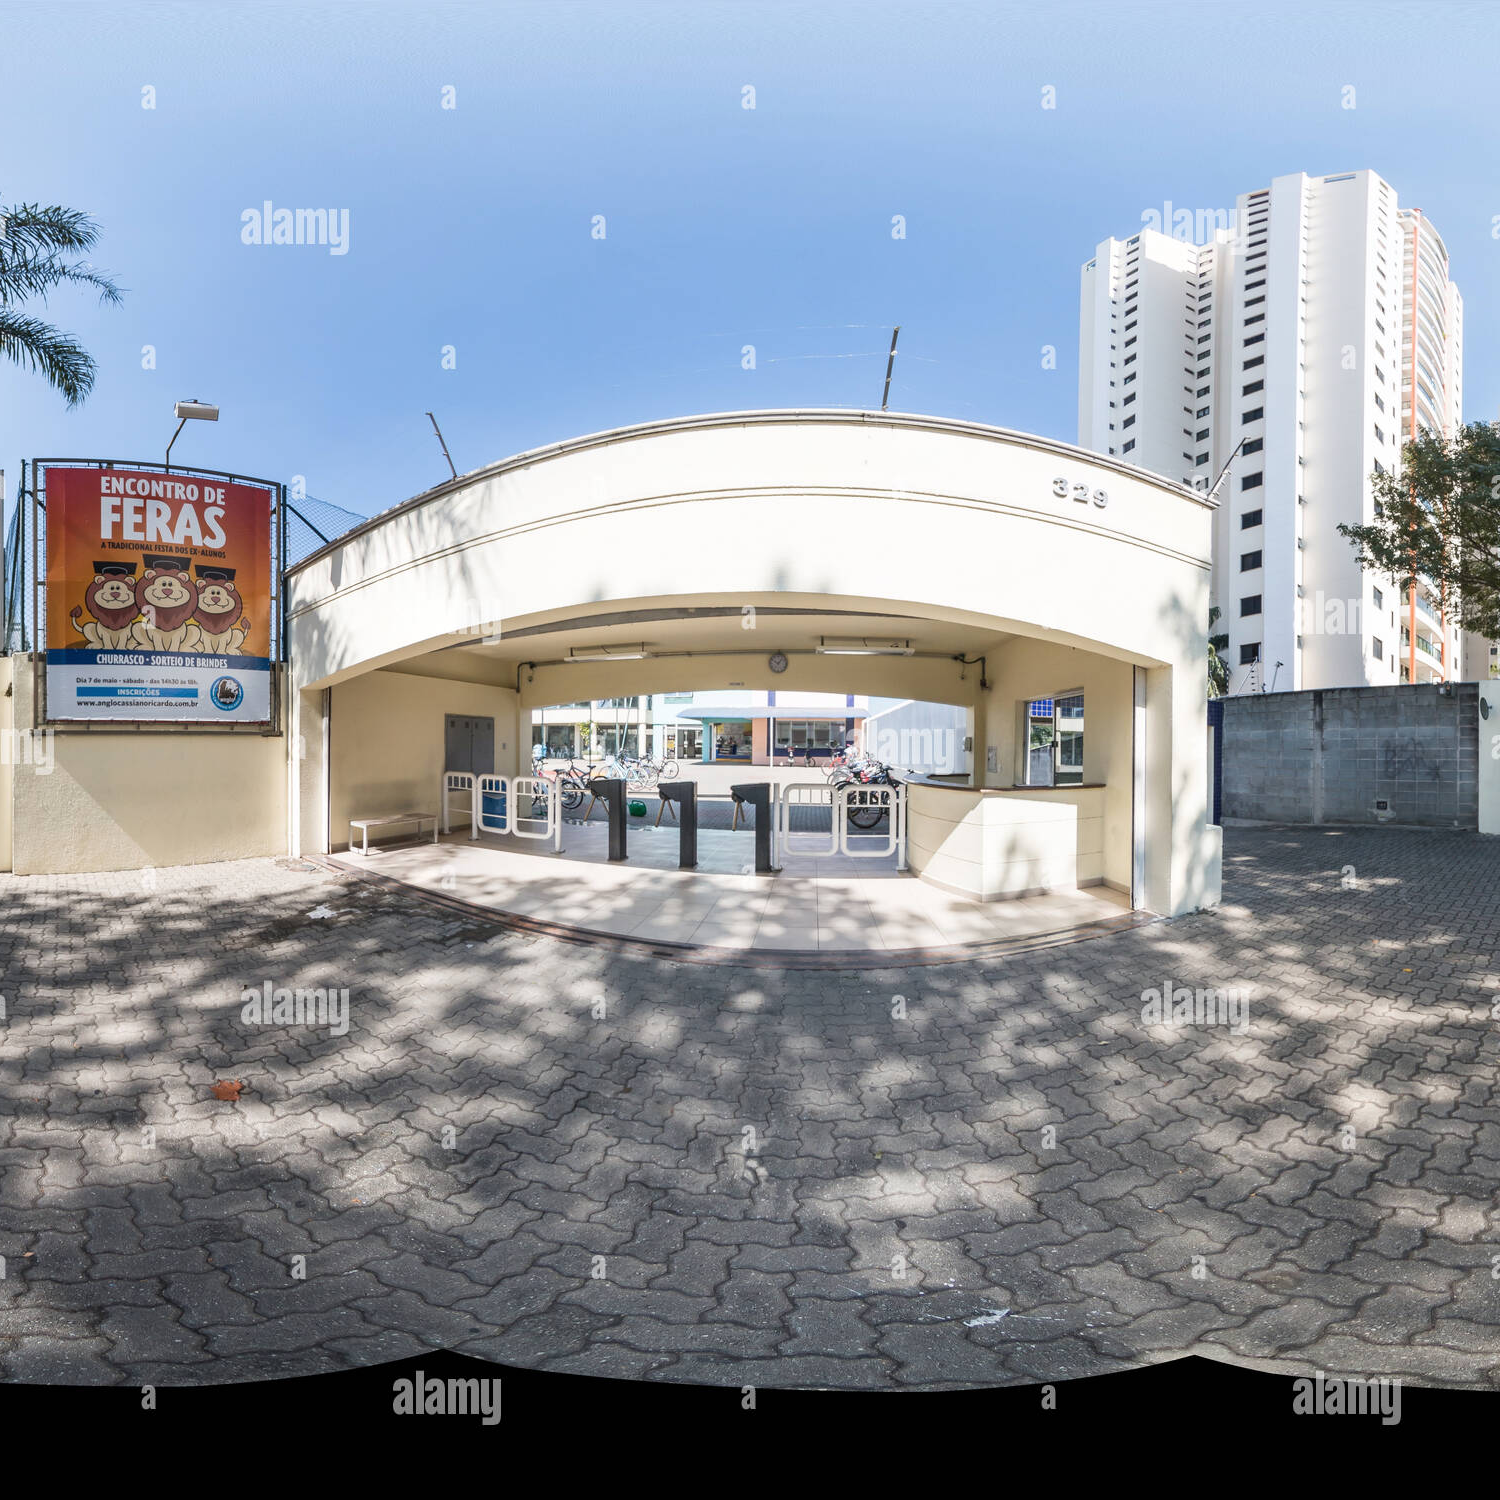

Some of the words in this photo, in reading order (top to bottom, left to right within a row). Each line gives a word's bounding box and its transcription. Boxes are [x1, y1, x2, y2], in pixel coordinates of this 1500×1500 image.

[101, 476, 199, 501] ENCONTRO
[204, 487, 226, 506] DE
[1052, 477, 1109, 509] 329
[100, 496, 227, 549] FERAS
[107, 542, 153, 552] TRADICIONAL
[154, 545, 174, 553] FESTA
[96, 653, 145, 665] CHURRASCO
[150, 655, 184, 666] SORTEIO
[185, 657, 195, 667] DE
[196, 658, 228, 668] BRINDES
[76, 698, 199, 708] www.anglocassianoricardo.com.br
